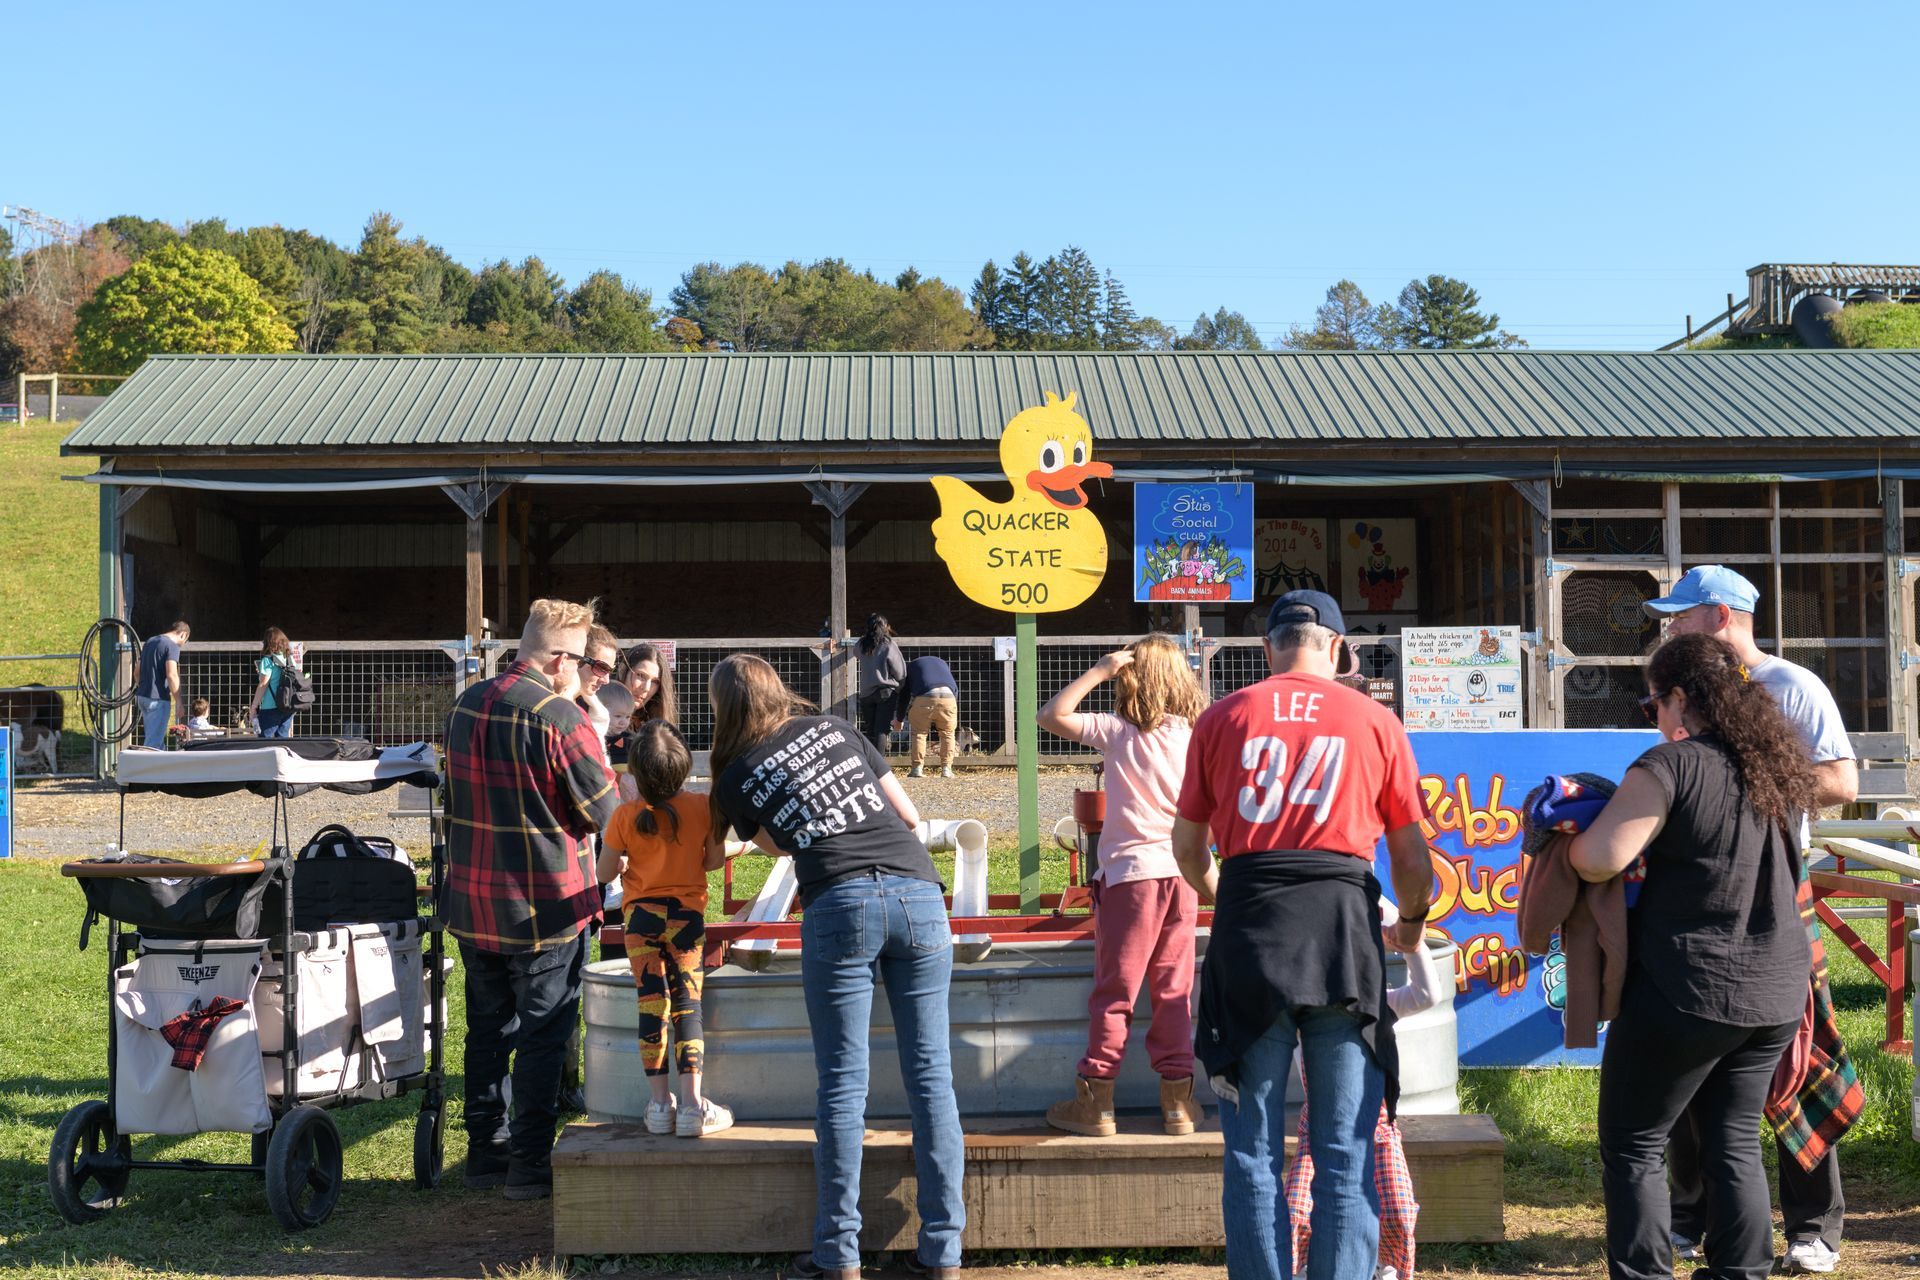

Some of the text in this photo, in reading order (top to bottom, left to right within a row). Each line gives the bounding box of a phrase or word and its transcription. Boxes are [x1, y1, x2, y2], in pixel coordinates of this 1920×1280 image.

[1173, 495, 1211, 513] Stu's
[963, 510, 1070, 536] QUACKER
[1171, 515, 1217, 528] Social
[1264, 538, 1297, 553] 2014
[1267, 519, 1322, 551] The Big Top
[987, 547, 1062, 568] STATE
[1001, 582, 1049, 605] 500
[1369, 682, 1394, 690] ARE PIGS
[1370, 692, 1393, 700] SMART?
[1273, 691, 1324, 723] LEE
[1498, 710, 1517, 719] FACT
[753, 726, 819, 781] FORGET
[752, 731, 845, 808] GLASS SLIPPERS
[1238, 735, 1345, 825] 34
[772, 755, 862, 827] THIS PRINCESS
[799, 778, 851, 821] WEARS
[1419, 776, 1525, 847] Rubb
[1424, 848, 1533, 922] Duc
[185, 966, 211, 979] KEENZ
